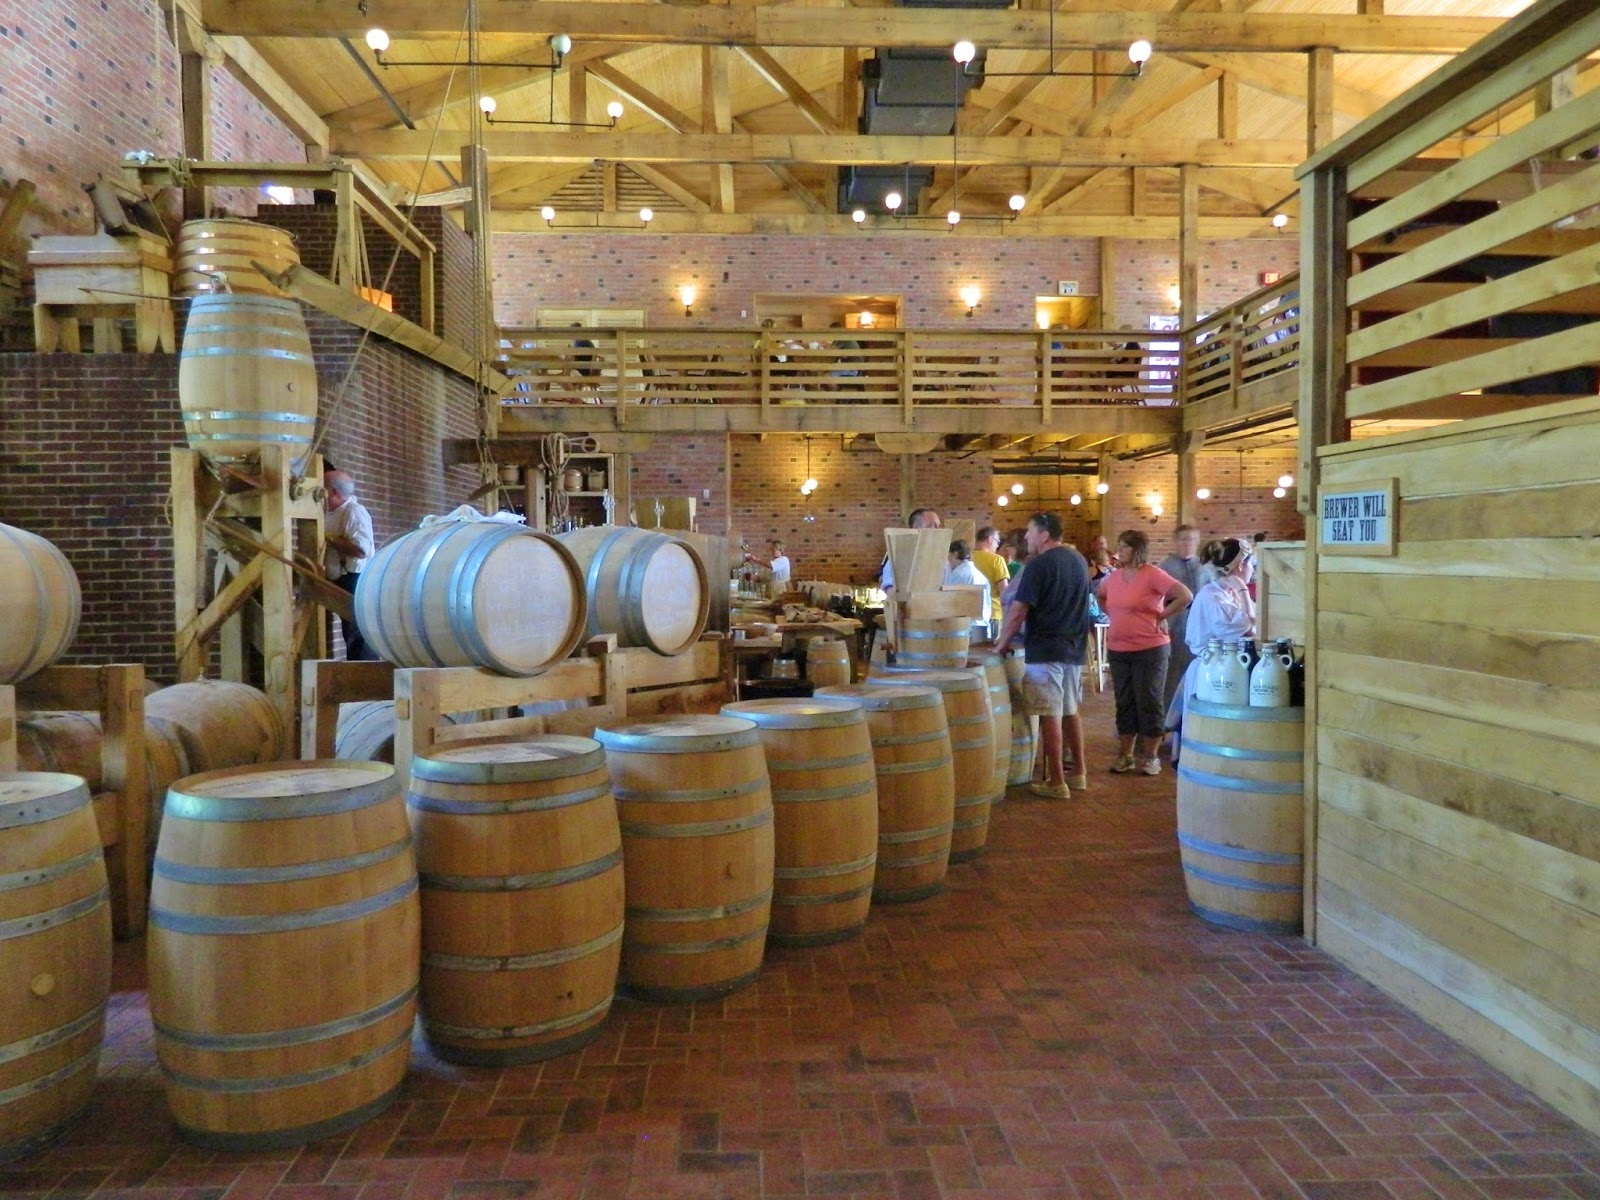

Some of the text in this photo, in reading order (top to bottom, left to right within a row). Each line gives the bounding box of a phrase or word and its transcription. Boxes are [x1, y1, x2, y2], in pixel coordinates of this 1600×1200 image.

[1324, 495, 1386, 519] BREWER WILL
[1332, 520, 1376, 541] SEAT YOU
